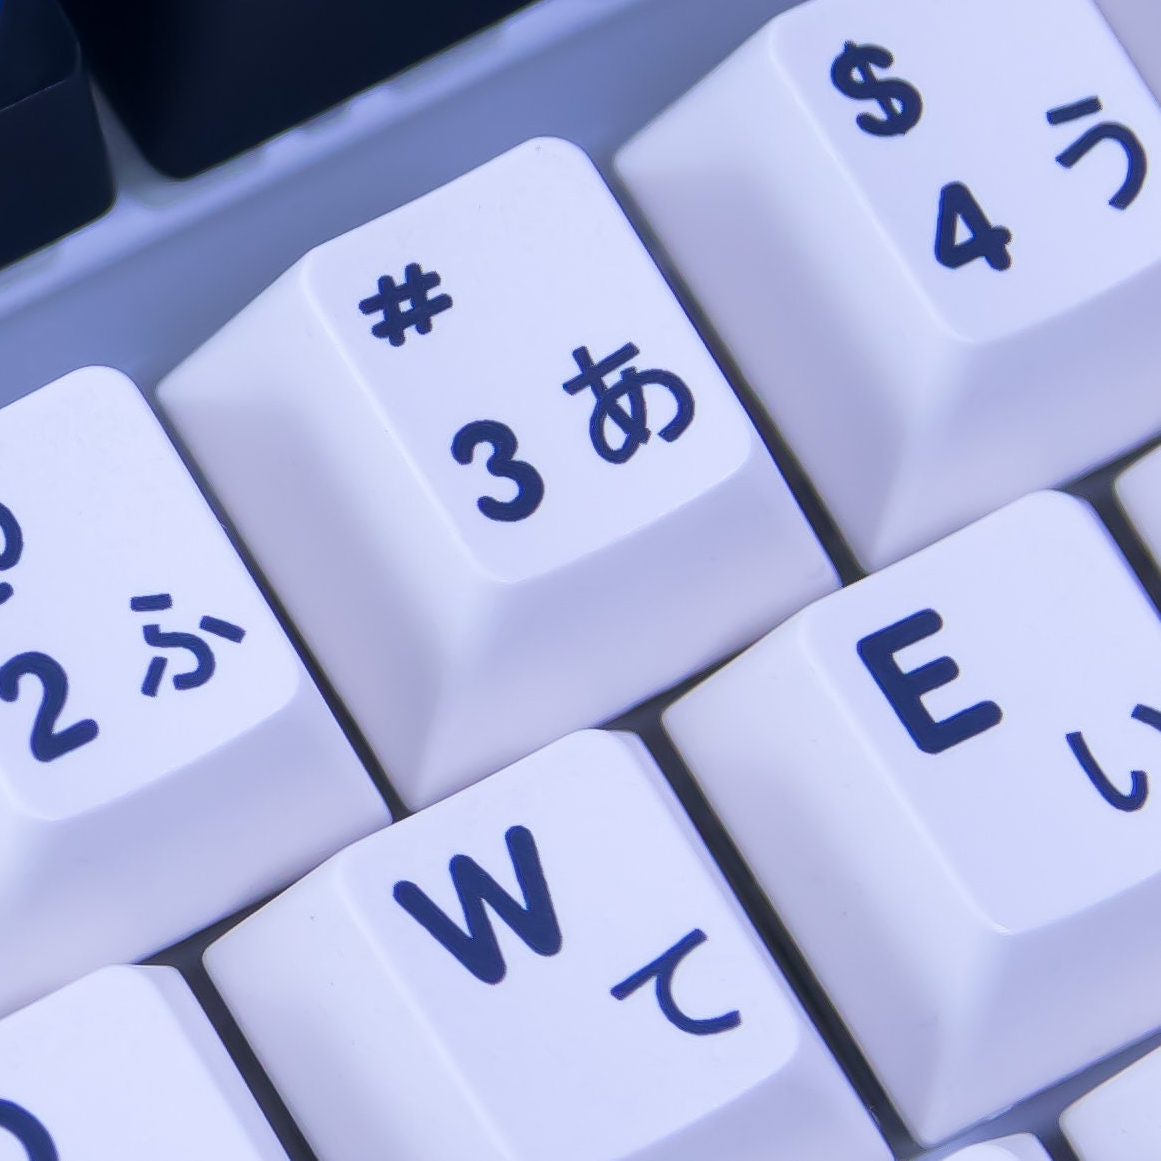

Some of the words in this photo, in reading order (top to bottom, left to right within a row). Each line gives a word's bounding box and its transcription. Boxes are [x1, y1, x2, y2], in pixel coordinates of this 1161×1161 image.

[830, 41, 923, 138] $
[1046, 96, 1148, 211] う
[934, 181, 1012, 272] 4
[358, 262, 453, 348] #
[562, 342, 696, 465] あ
[450, 419, 545, 523] 3
[130, 593, 246, 698] ふ
[856, 608, 1003, 755] E
[392, 825, 563, 986] W
[610, 928, 741, 1036] て
